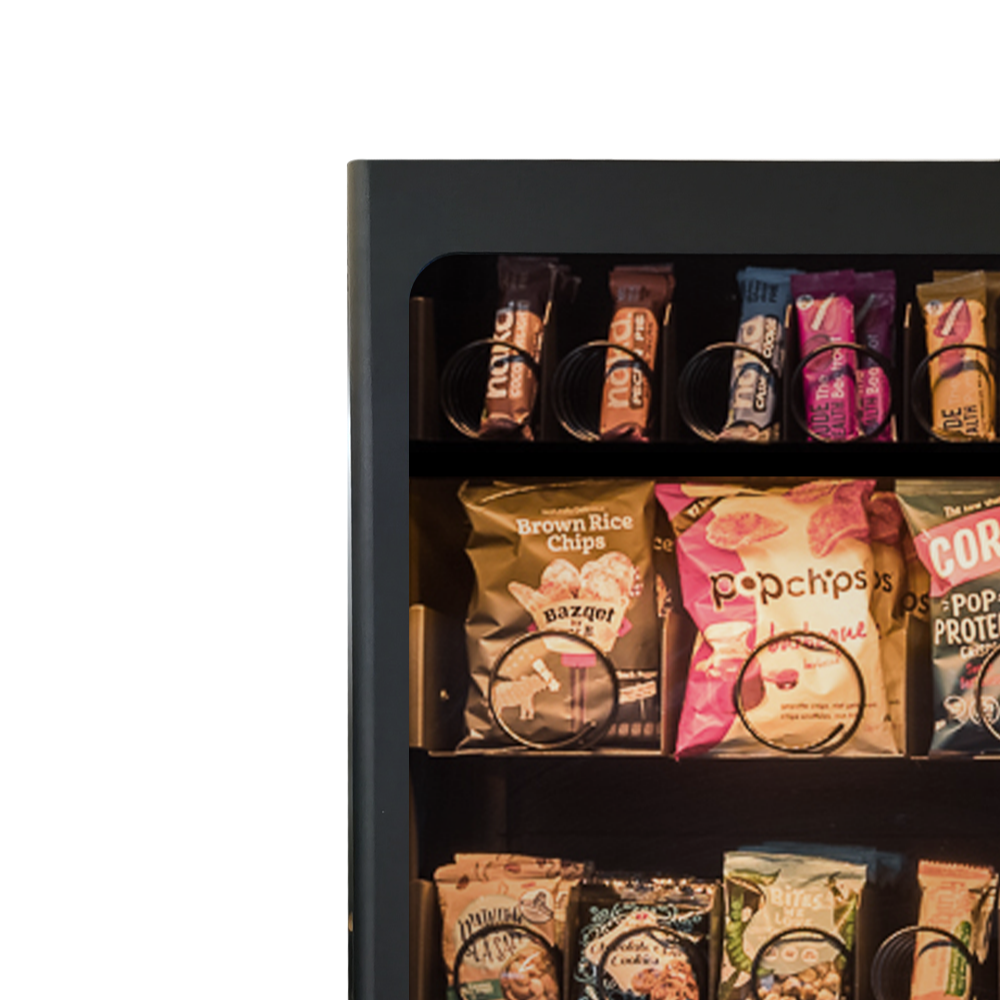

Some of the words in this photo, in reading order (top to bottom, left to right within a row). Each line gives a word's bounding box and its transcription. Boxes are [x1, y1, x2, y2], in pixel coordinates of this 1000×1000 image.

[516, 518, 586, 535] Brown
[588, 512, 634, 531] Rice
[546, 533, 606, 555] Chips
[710, 567, 868, 611] popchips
[951, 588, 996, 617] POP
[543, 605, 615, 624] Bazqet
